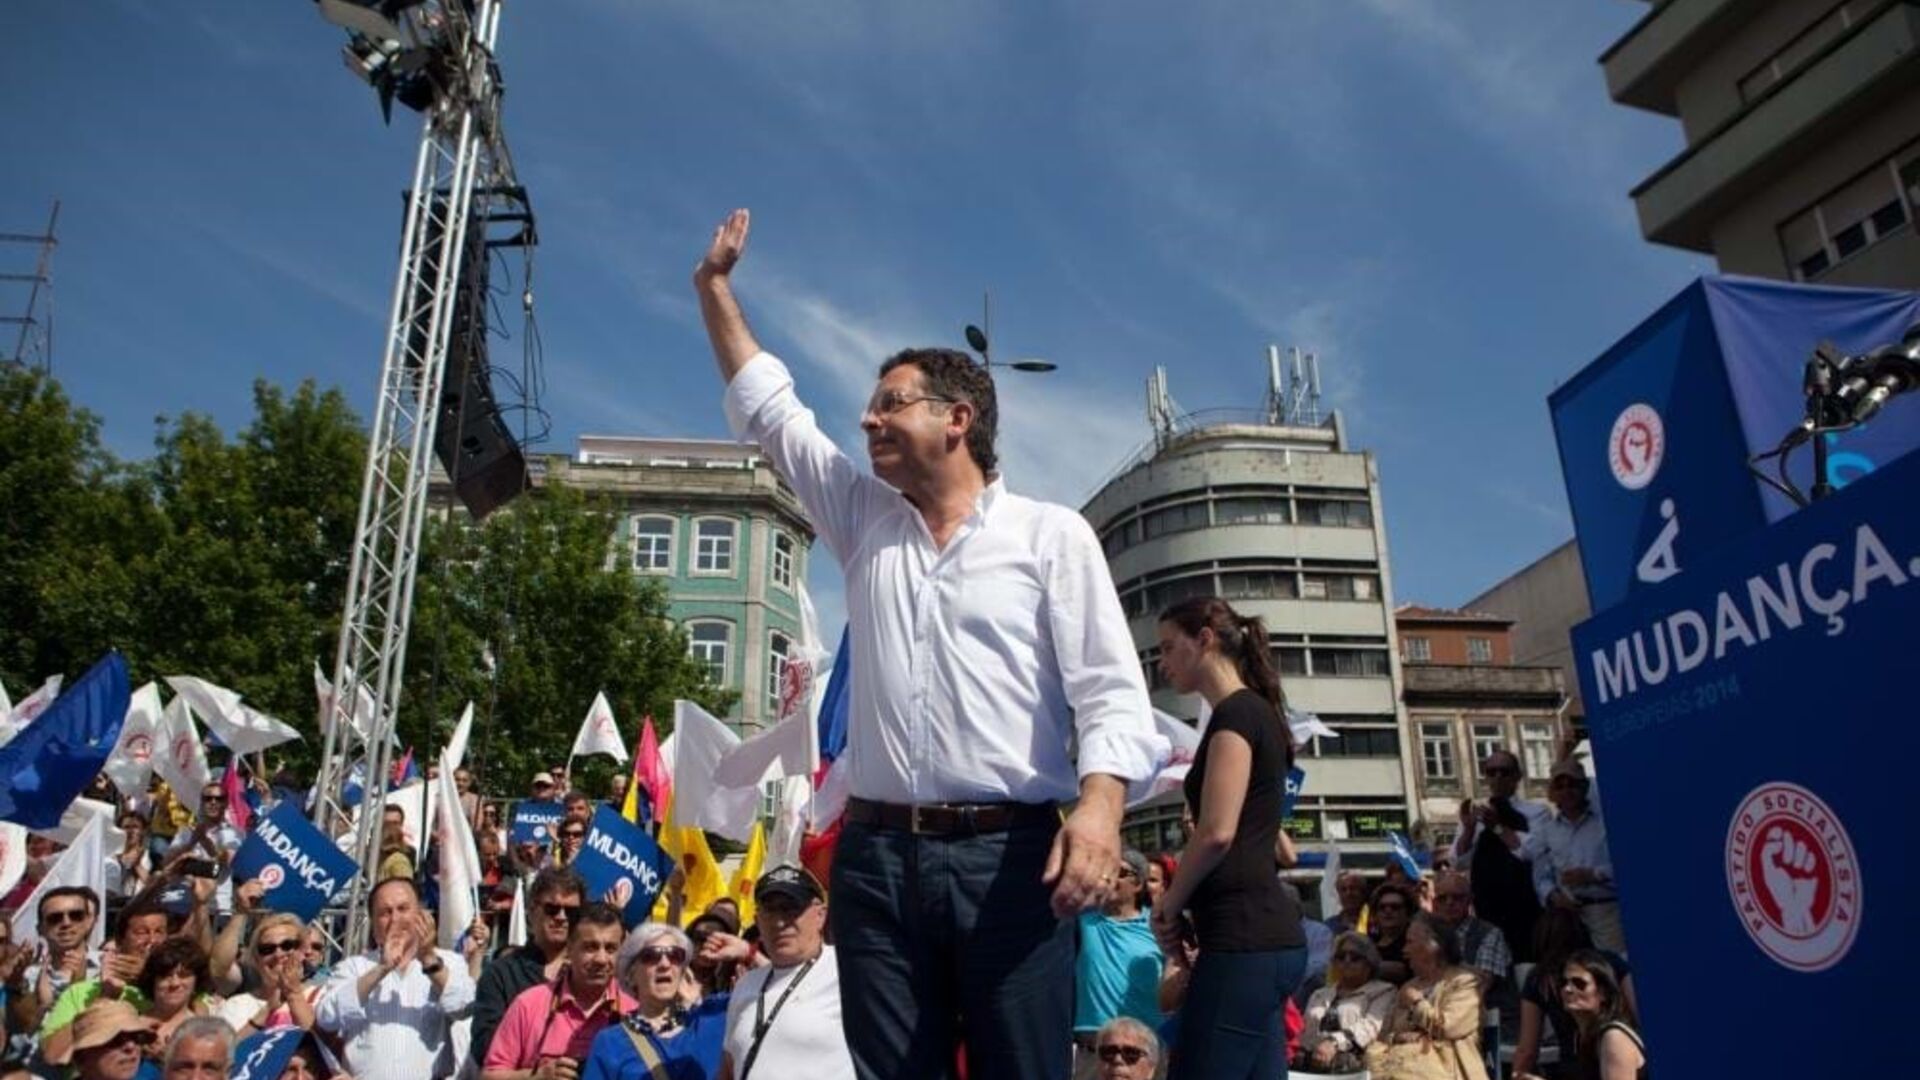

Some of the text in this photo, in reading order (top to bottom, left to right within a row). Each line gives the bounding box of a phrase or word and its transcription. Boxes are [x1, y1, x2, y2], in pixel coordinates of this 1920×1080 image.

[1694, 673, 1741, 709] 2014
[256, 818, 335, 899] MUDANÇA
[1732, 793, 1854, 933] PARTIDO SOCIALISTA
